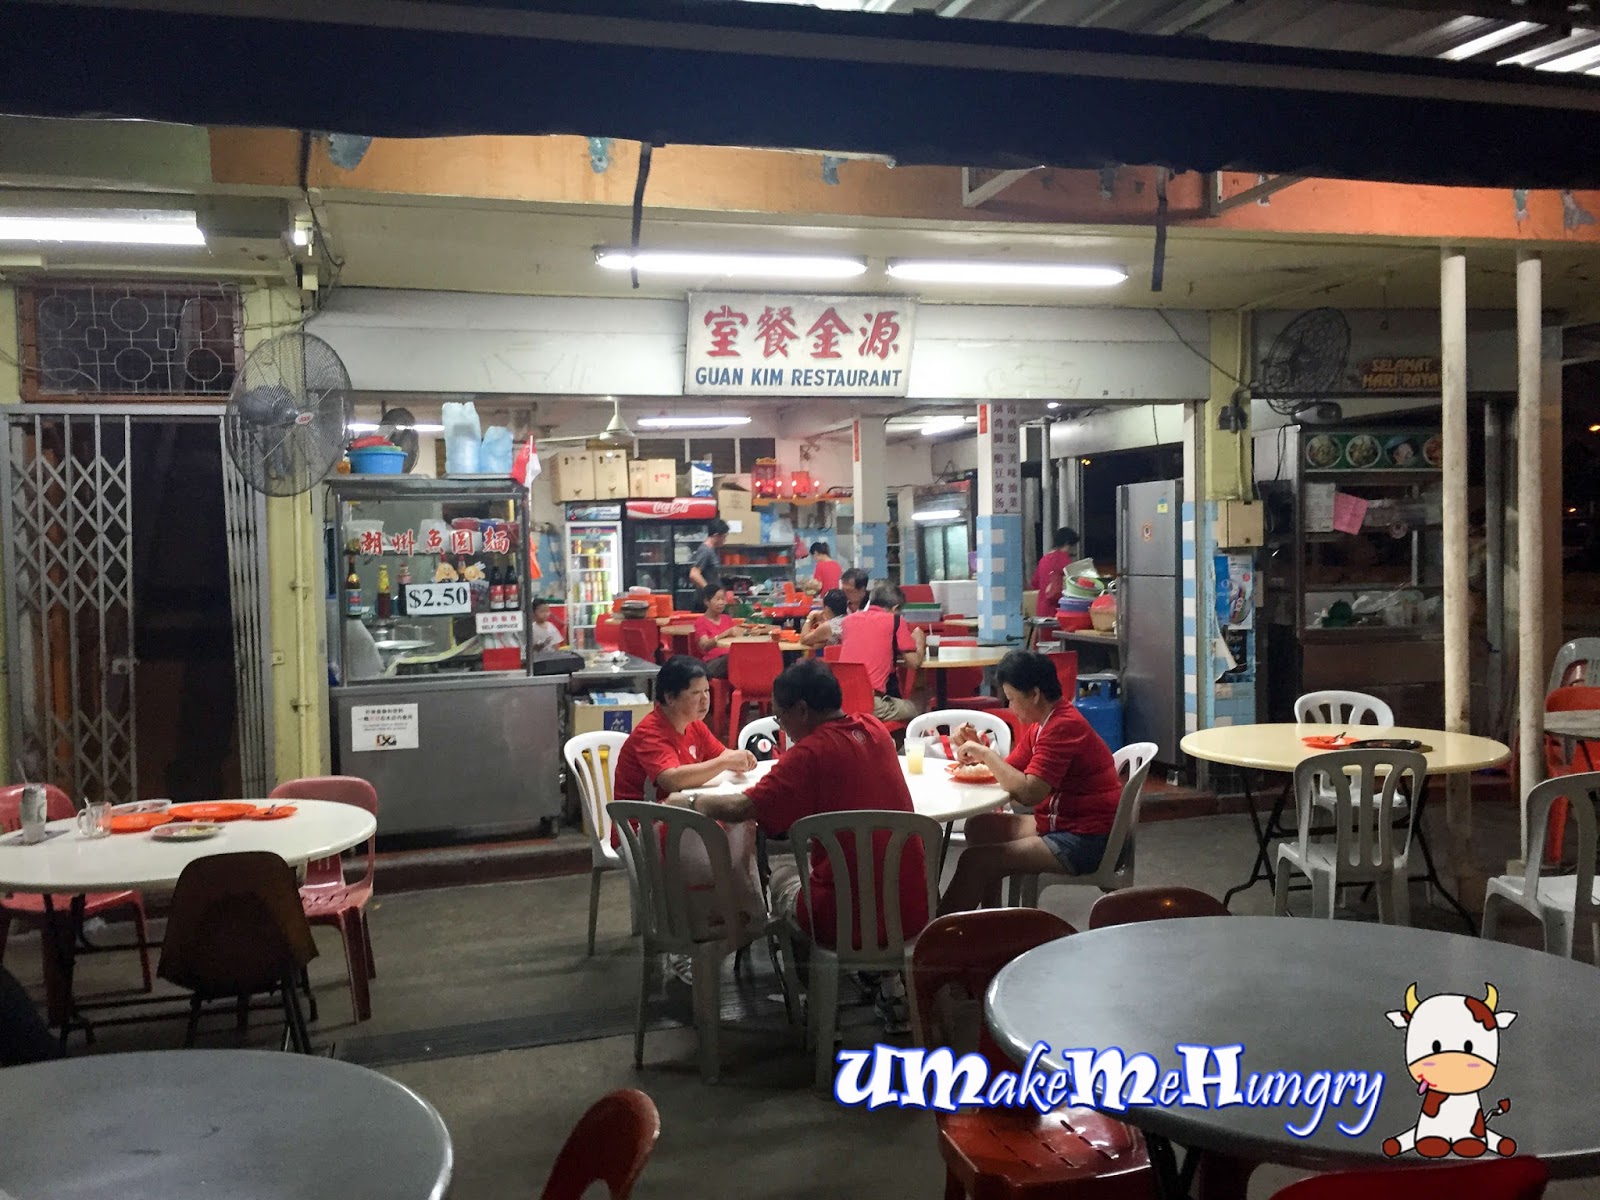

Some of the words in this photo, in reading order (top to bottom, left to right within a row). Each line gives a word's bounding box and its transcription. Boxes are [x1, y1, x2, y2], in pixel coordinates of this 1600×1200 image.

[695, 367, 743, 386] GUAN
[751, 368, 783, 386] KIM
[791, 368, 902, 387] RESTAURANT
[408, 586, 468, 608] $2.50
